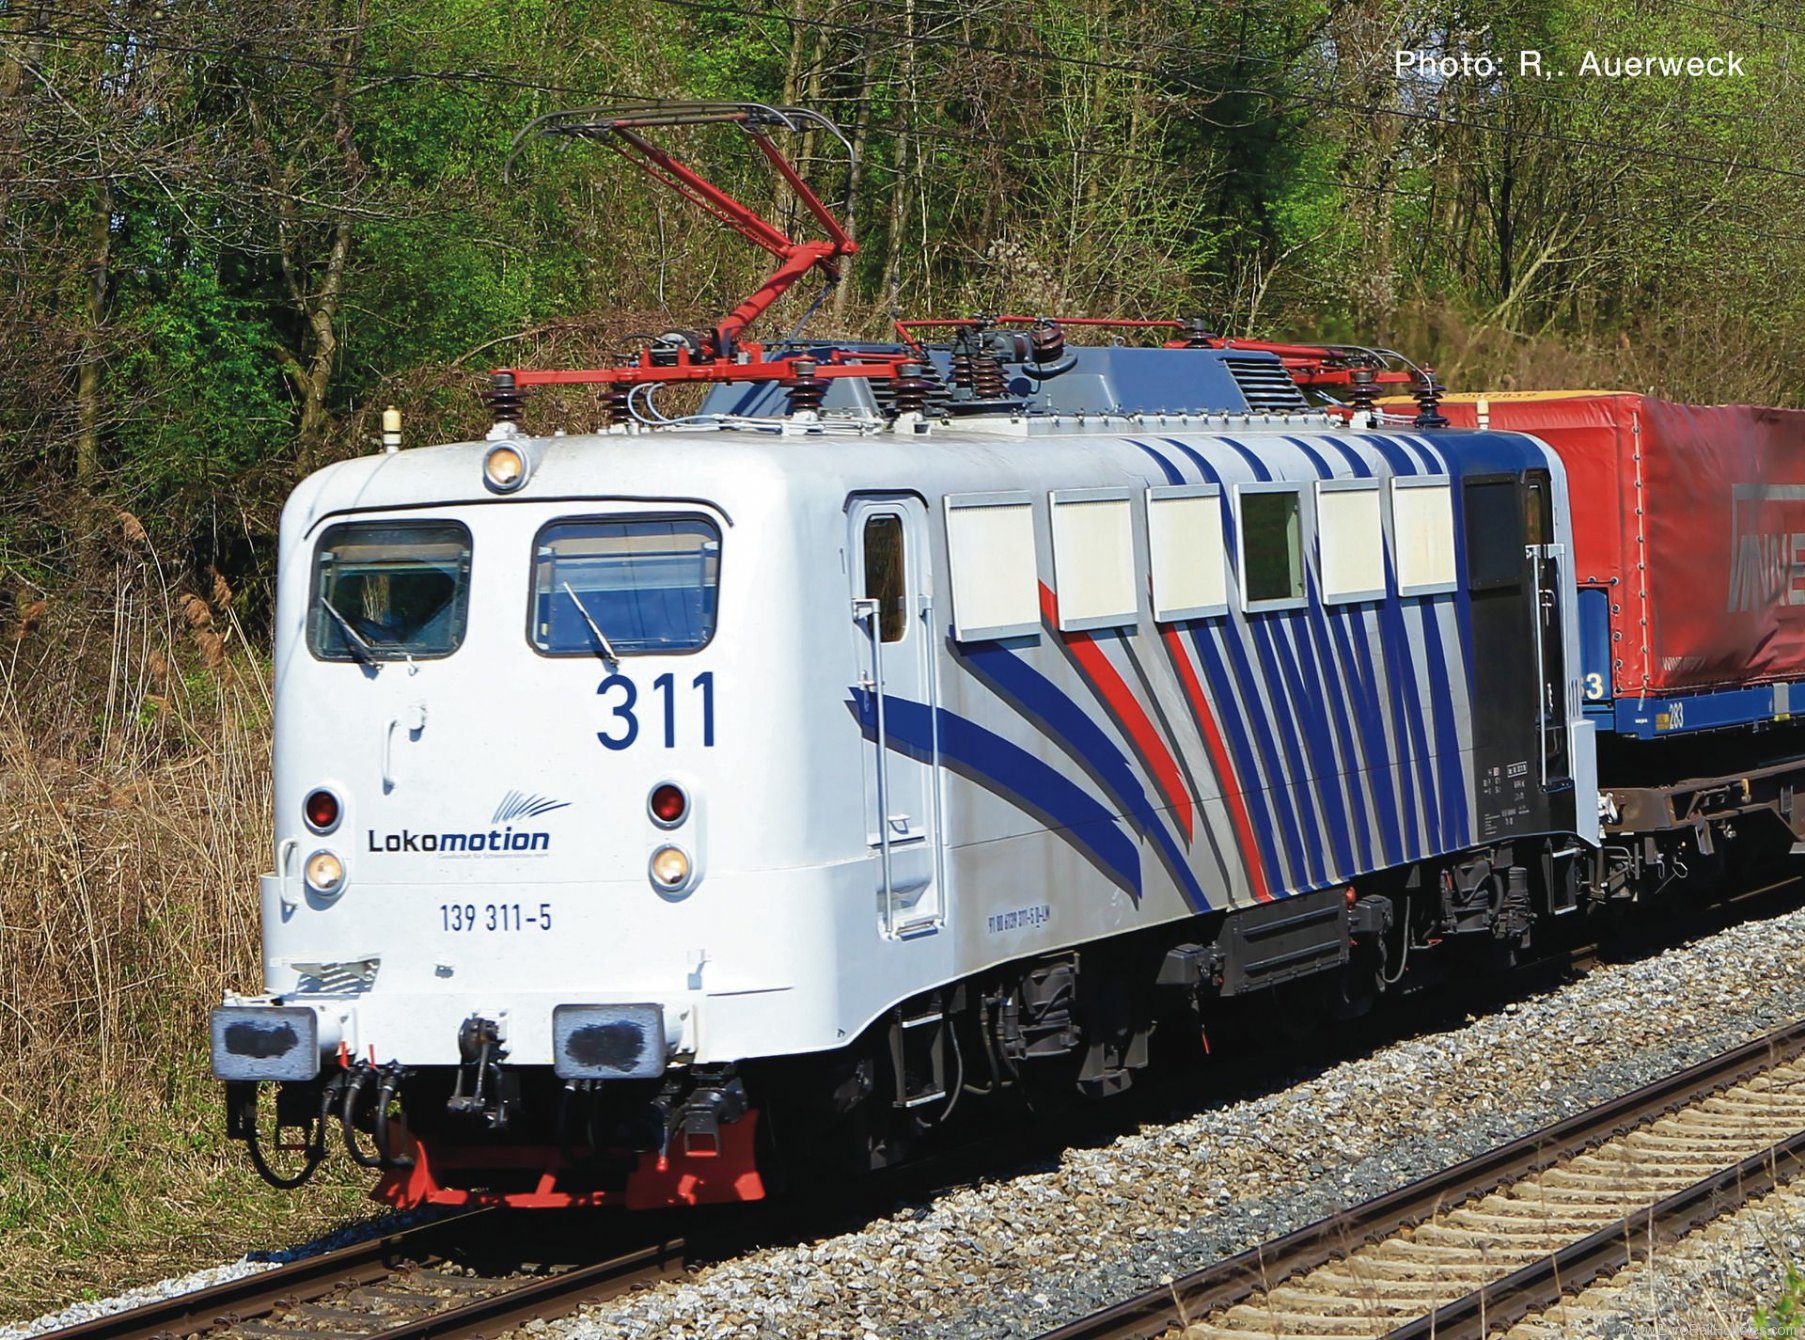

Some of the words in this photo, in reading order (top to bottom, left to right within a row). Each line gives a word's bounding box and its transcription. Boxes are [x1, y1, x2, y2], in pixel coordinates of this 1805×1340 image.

[1580, 672, 1604, 700] 3
[596, 671, 715, 751] 311
[1669, 701, 1684, 730] 283
[368, 826, 550, 852] Lokomotion
[440, 904, 476, 931] 139
[485, 903, 551, 931] 311-5
